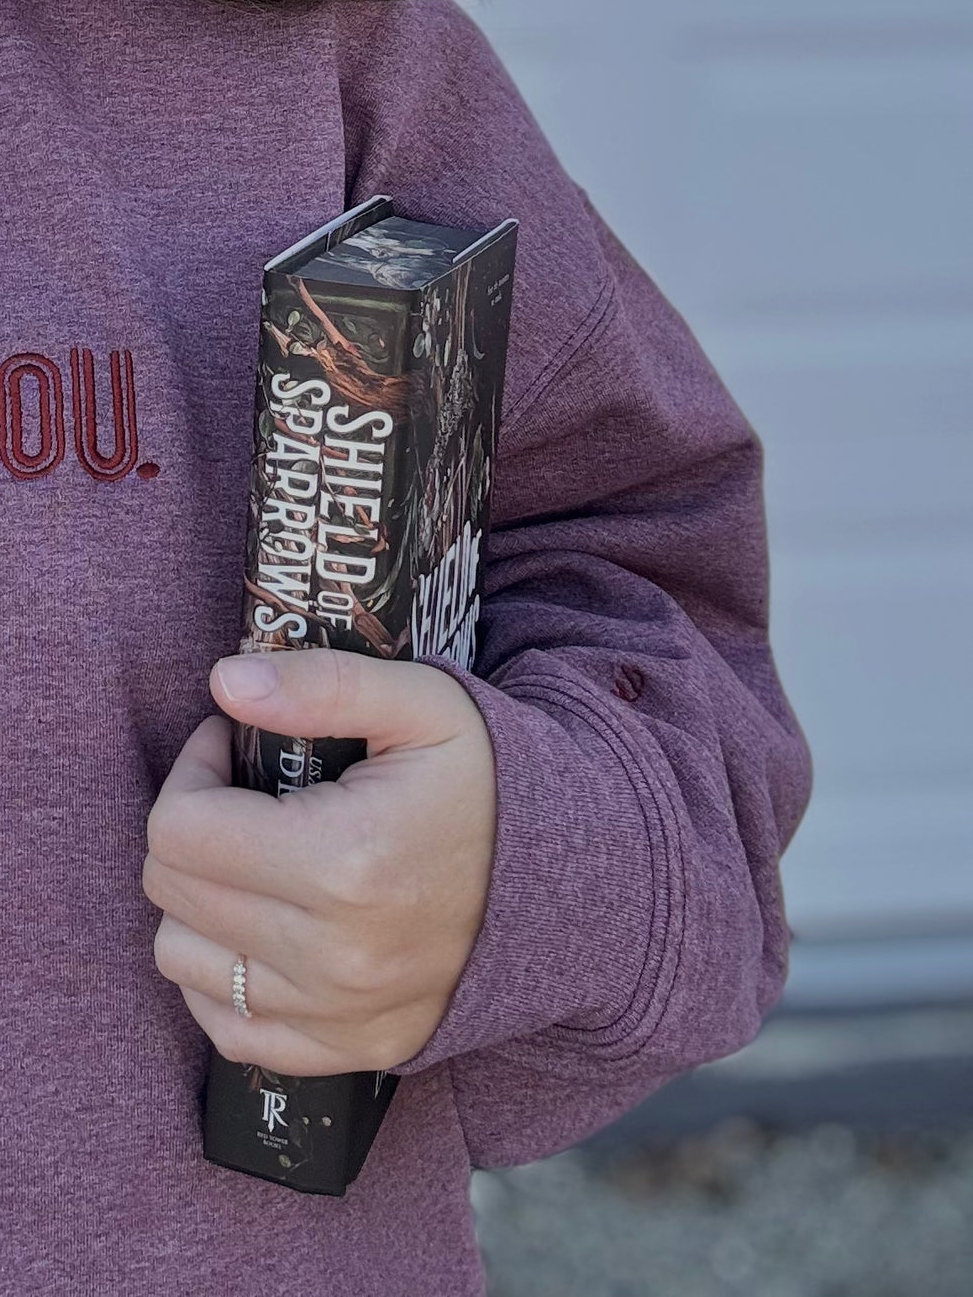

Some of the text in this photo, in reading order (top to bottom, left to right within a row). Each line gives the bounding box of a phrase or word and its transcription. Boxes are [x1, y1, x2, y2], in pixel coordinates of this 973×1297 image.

[254, 373, 331, 640] SPARROWS
[315, 405, 393, 631] SHIELD OF
